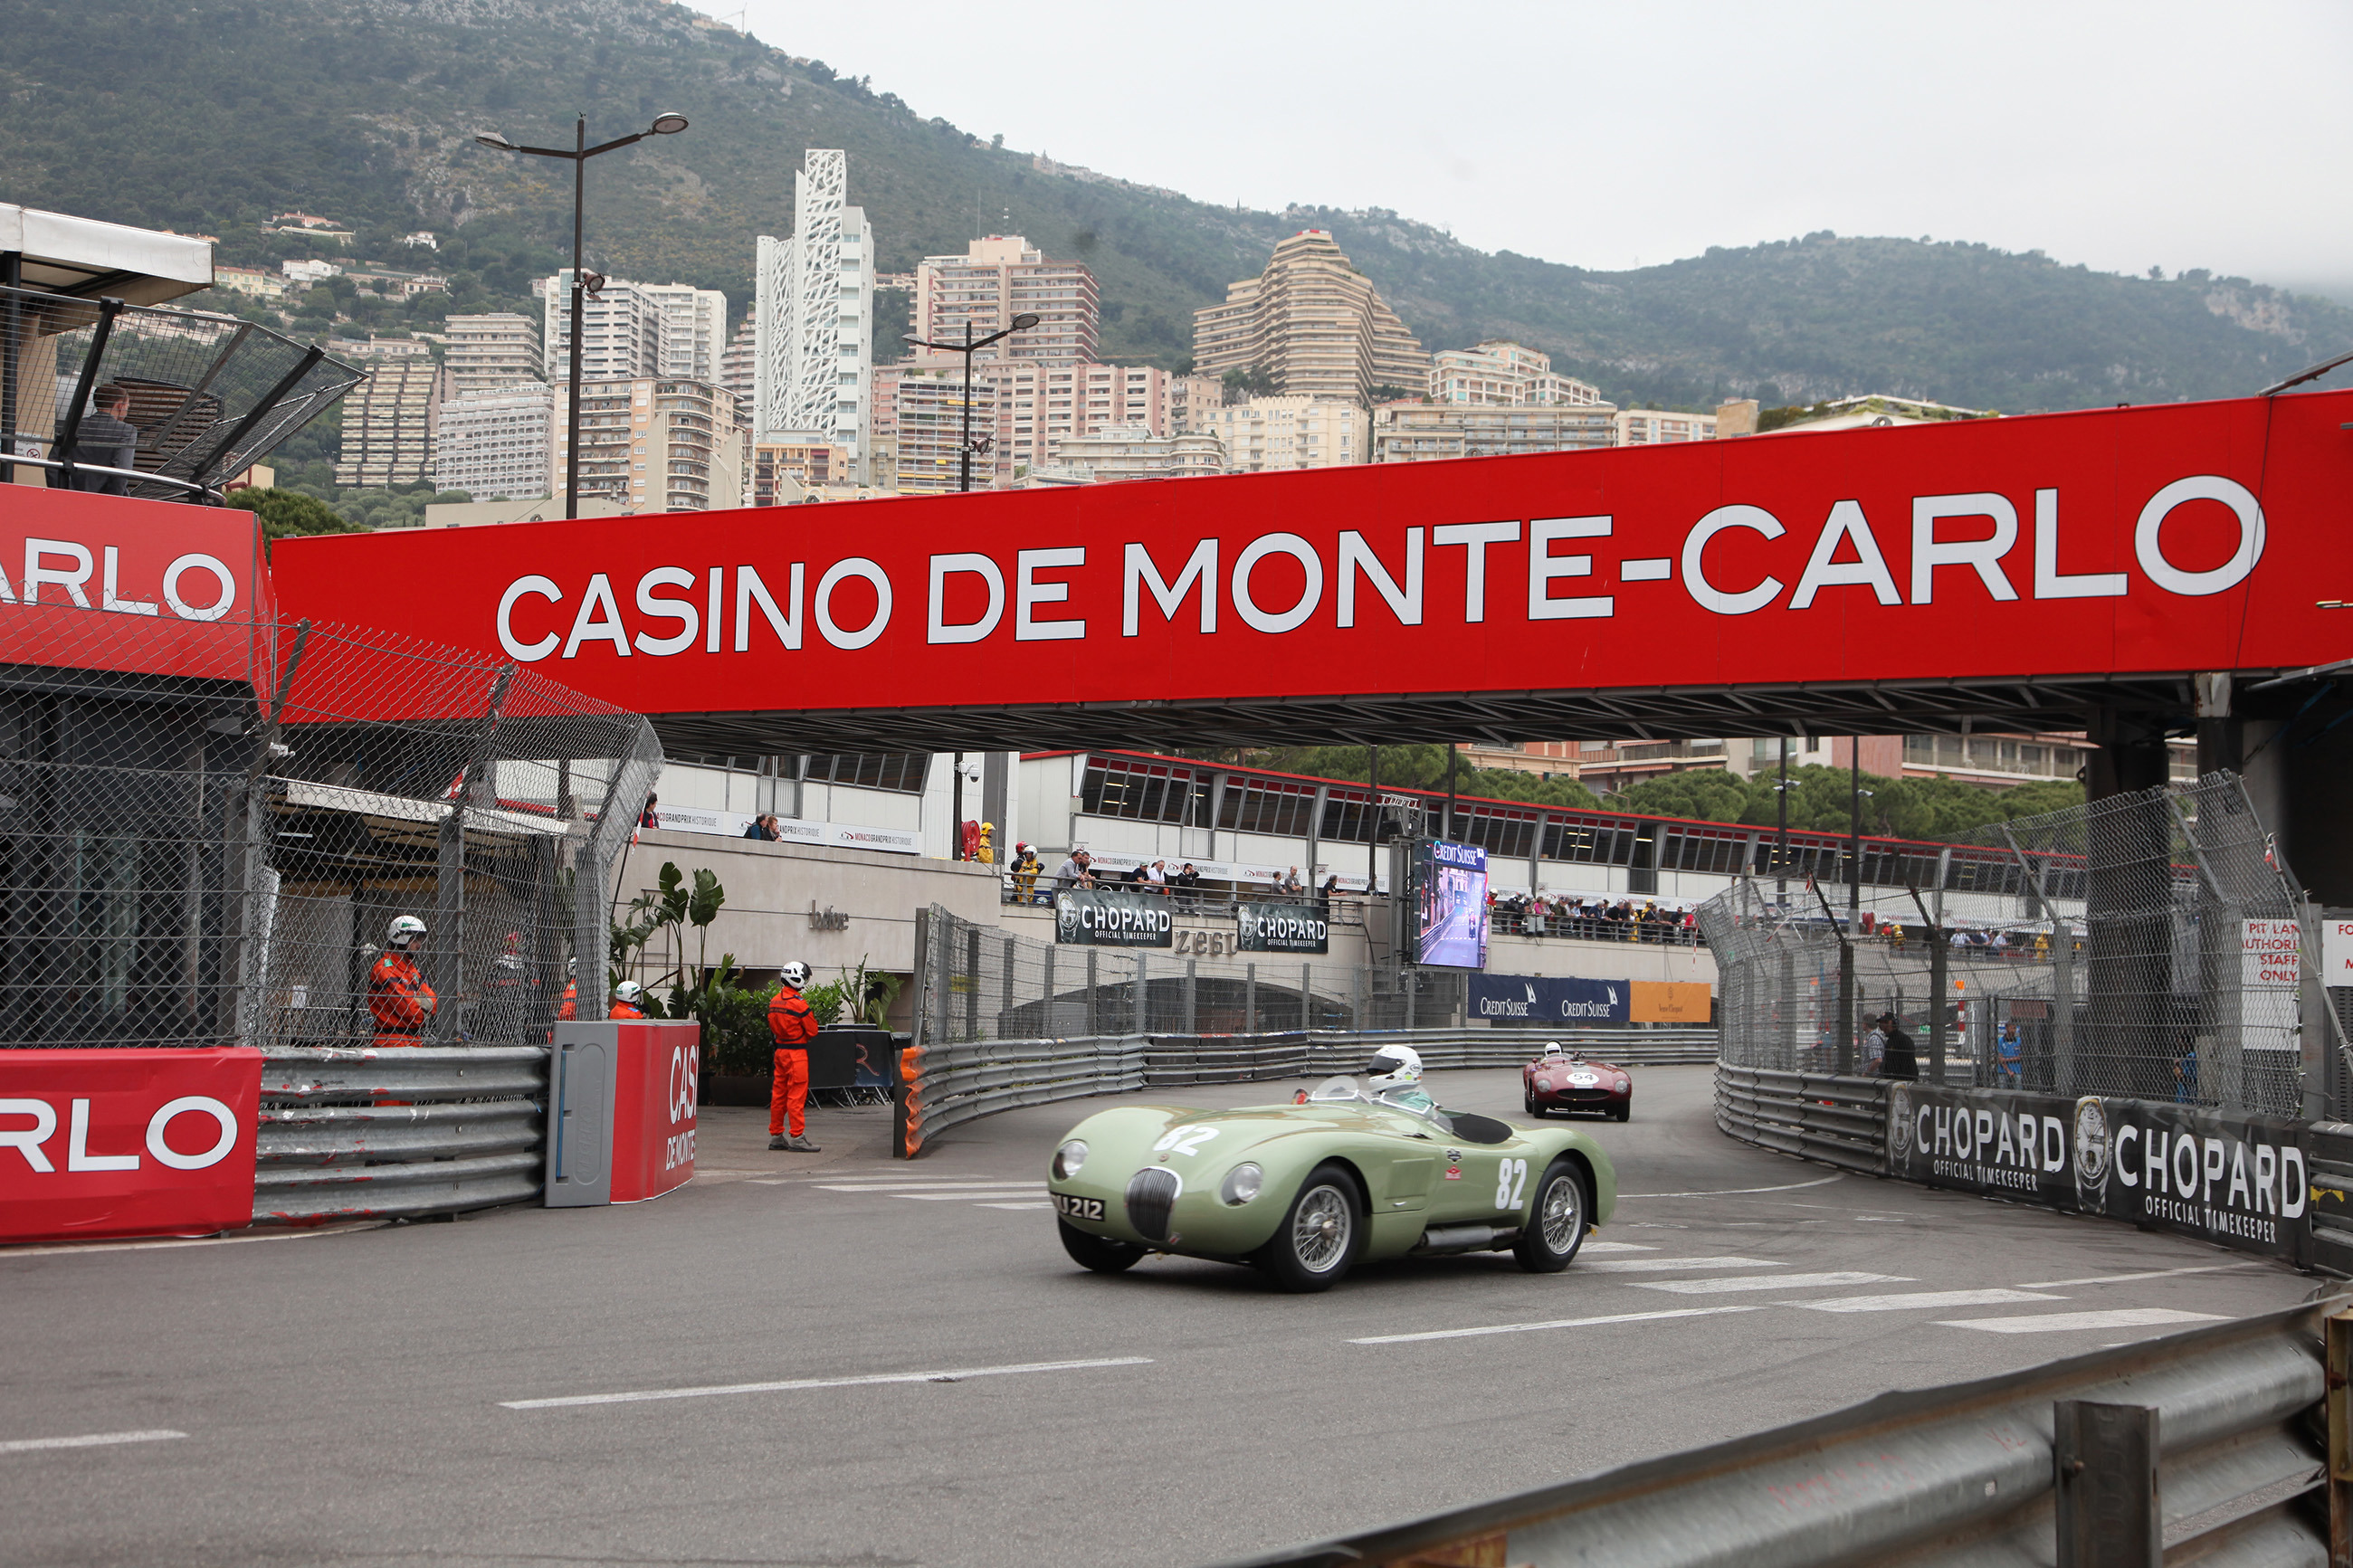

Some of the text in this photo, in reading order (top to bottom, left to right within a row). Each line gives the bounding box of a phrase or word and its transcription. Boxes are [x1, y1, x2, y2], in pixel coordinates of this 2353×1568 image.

[0, 536, 236, 622] RLO
[495, 474, 2267, 661] CASINO DE MONTE-CARLO
[808, 899, 849, 931] before
[1081, 905, 1170, 932] CHOPARD
[1257, 917, 1327, 940] CHOPARD
[2249, 923, 2300, 934] PIT LAN
[1094, 930, 1157, 941] OFFICIAL TIMEKEEPER
[1176, 930, 1237, 955] zest
[1268, 938, 1316, 947] OFFICIAL TIMEKEEPER
[2260, 955, 2298, 965] STAFF
[2260, 970, 2298, 982] ONLY
[1574, 1073, 1594, 1081] 54
[1152, 1125, 1221, 1158] 82
[1917, 1103, 2065, 1174] CHOPARD
[1494, 1157, 1528, 1211] 82
[1933, 1159, 2038, 1192] OFFICIAL TIMEKEEPER
[2114, 1125, 2306, 1219] CHOPARD
[2145, 1195, 2276, 1244] OFFICIAL TIMEKEEPER
